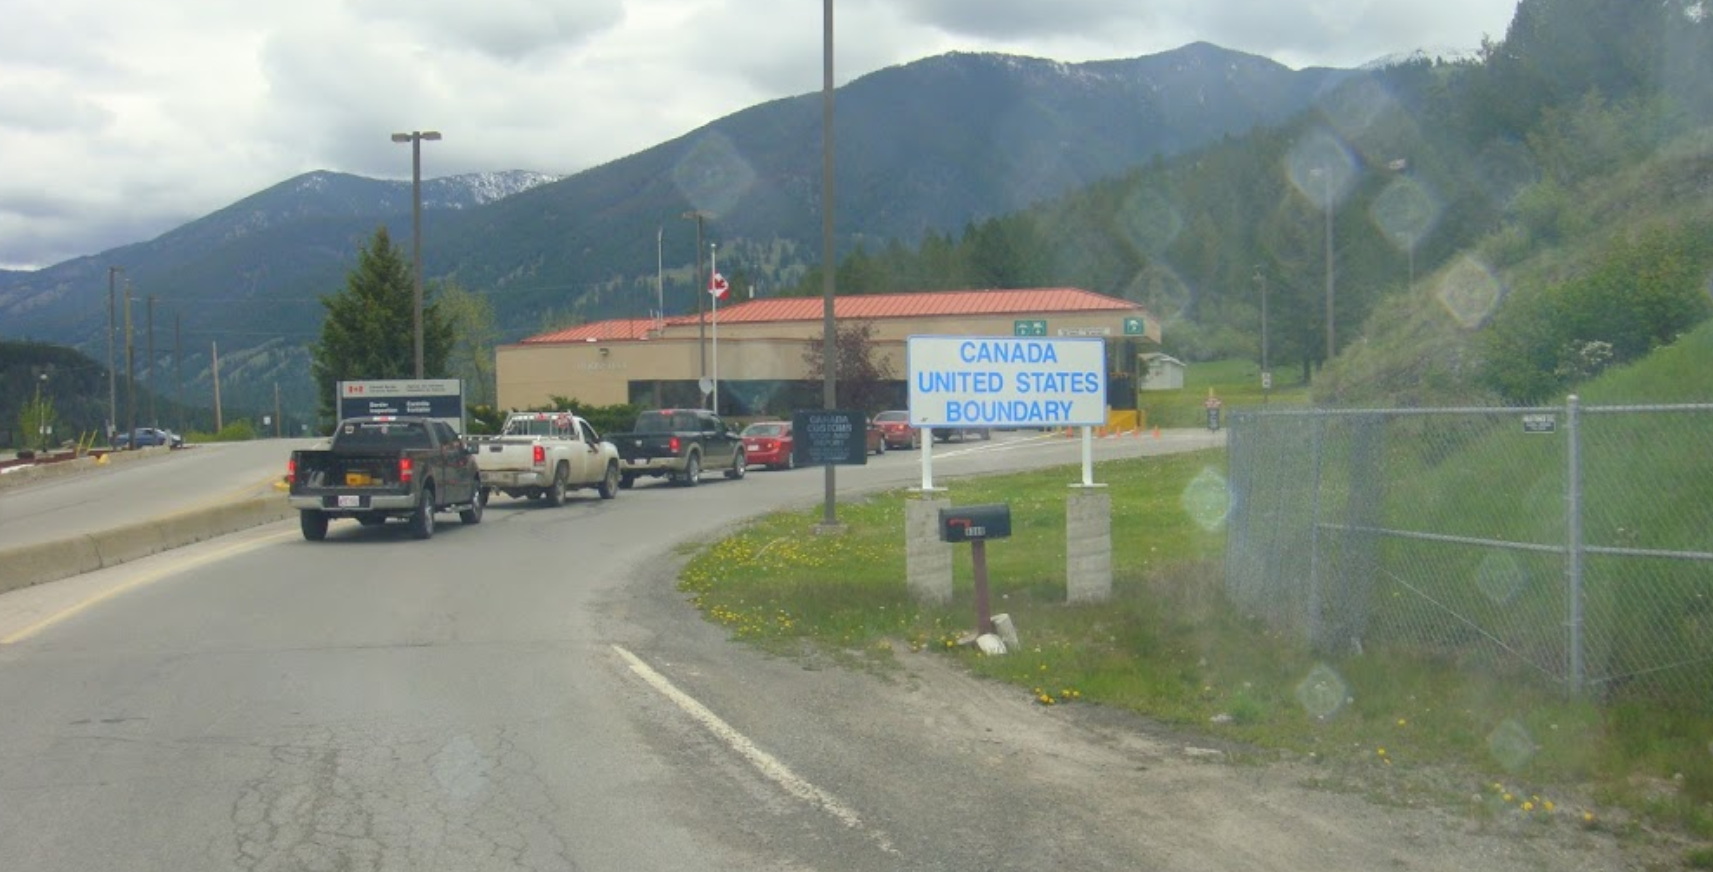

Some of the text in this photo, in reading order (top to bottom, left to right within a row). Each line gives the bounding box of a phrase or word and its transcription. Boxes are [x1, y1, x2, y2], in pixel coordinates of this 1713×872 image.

[960, 341, 1058, 364] CANADA
[918, 371, 1099, 394] UNITED STATES
[809, 415, 849, 423] CANADA
[946, 400, 1073, 422] BOUNDARY
[807, 424, 852, 432] CUSTOMS
